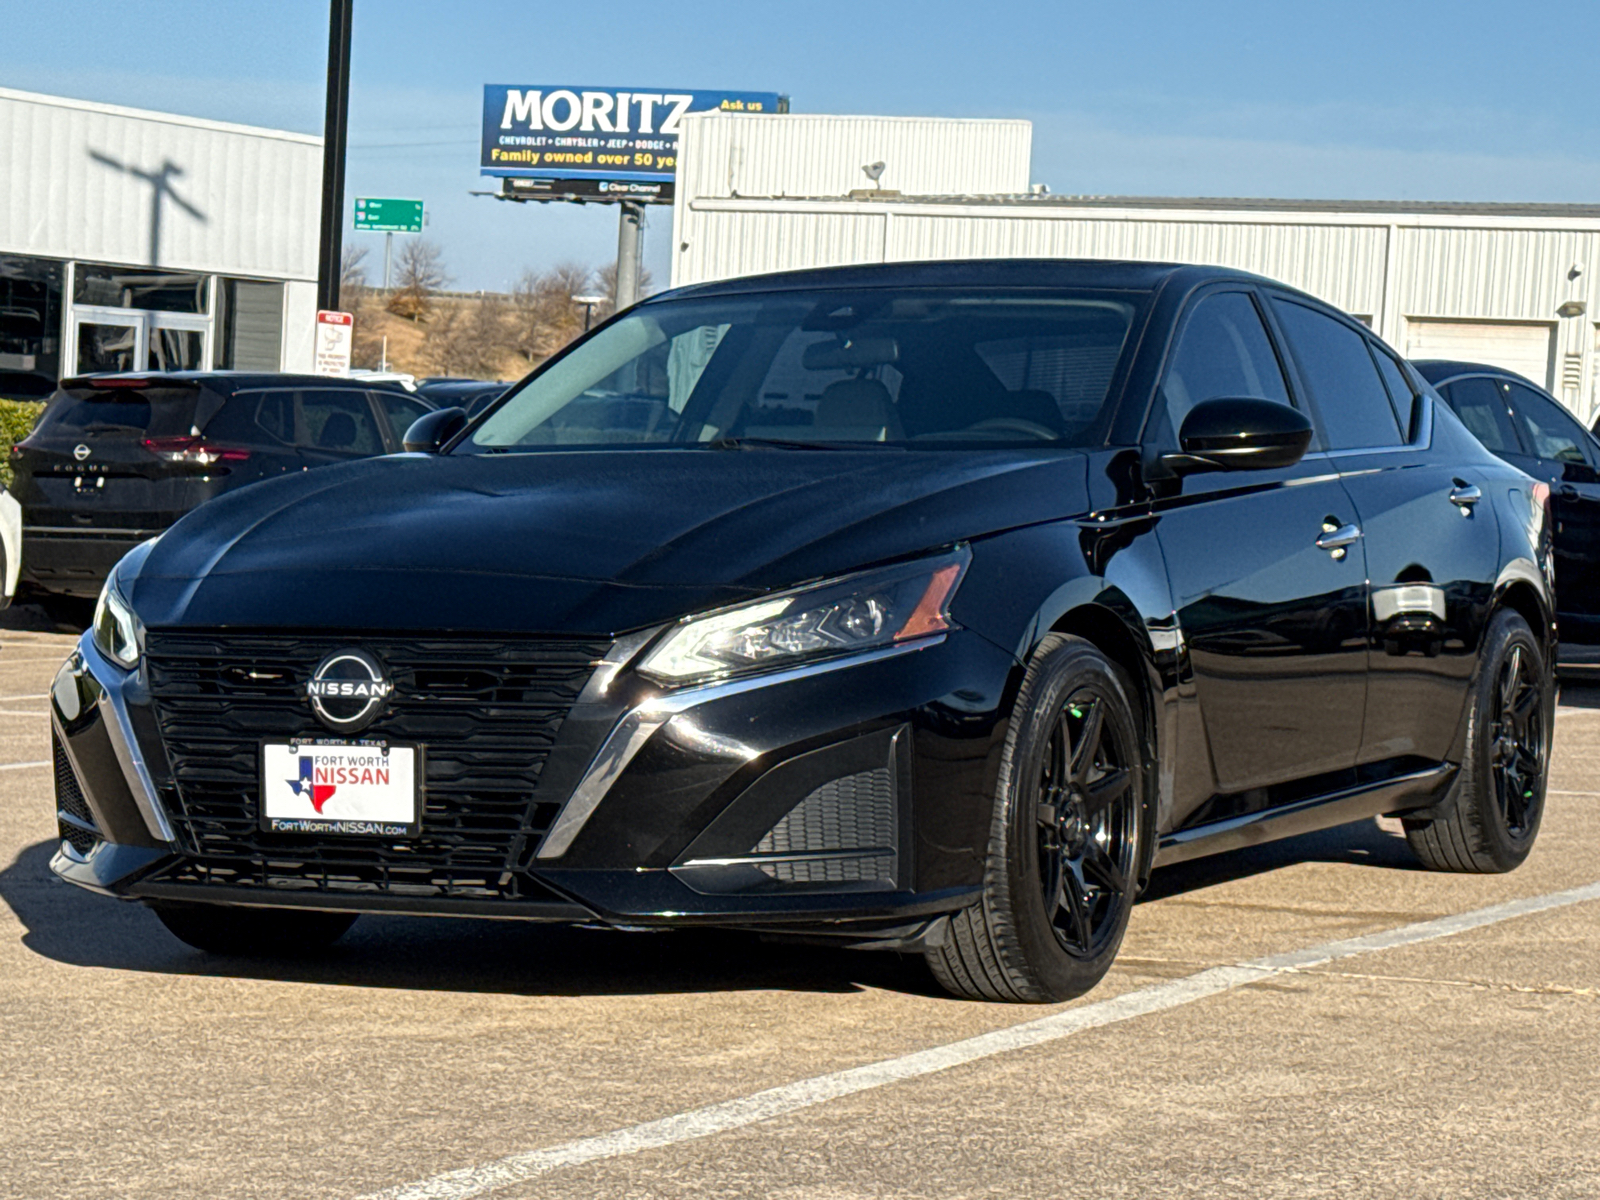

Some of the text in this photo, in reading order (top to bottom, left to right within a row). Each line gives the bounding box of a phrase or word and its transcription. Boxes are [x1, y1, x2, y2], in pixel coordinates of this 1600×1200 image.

[500, 89, 693, 134] MORITZ
[720, 99, 763, 111] Ask us
[499, 135, 547, 147] CHEVROLET
[555, 136, 599, 148] CHRYSLER
[606, 138, 628, 149] JEEP
[635, 139, 665, 151] DODGE
[491, 148, 540, 165] Family
[544, 151, 593, 164] owned
[597, 154, 630, 165] over
[634, 153, 653, 166] 50
[325, 315, 344, 324] NOTICE
[307, 682, 386, 696] NISSAN
[359, 739, 387, 747] TEXAS
[315, 755, 389, 767] FORT WORTH
[315, 767, 389, 785] NISSAN
